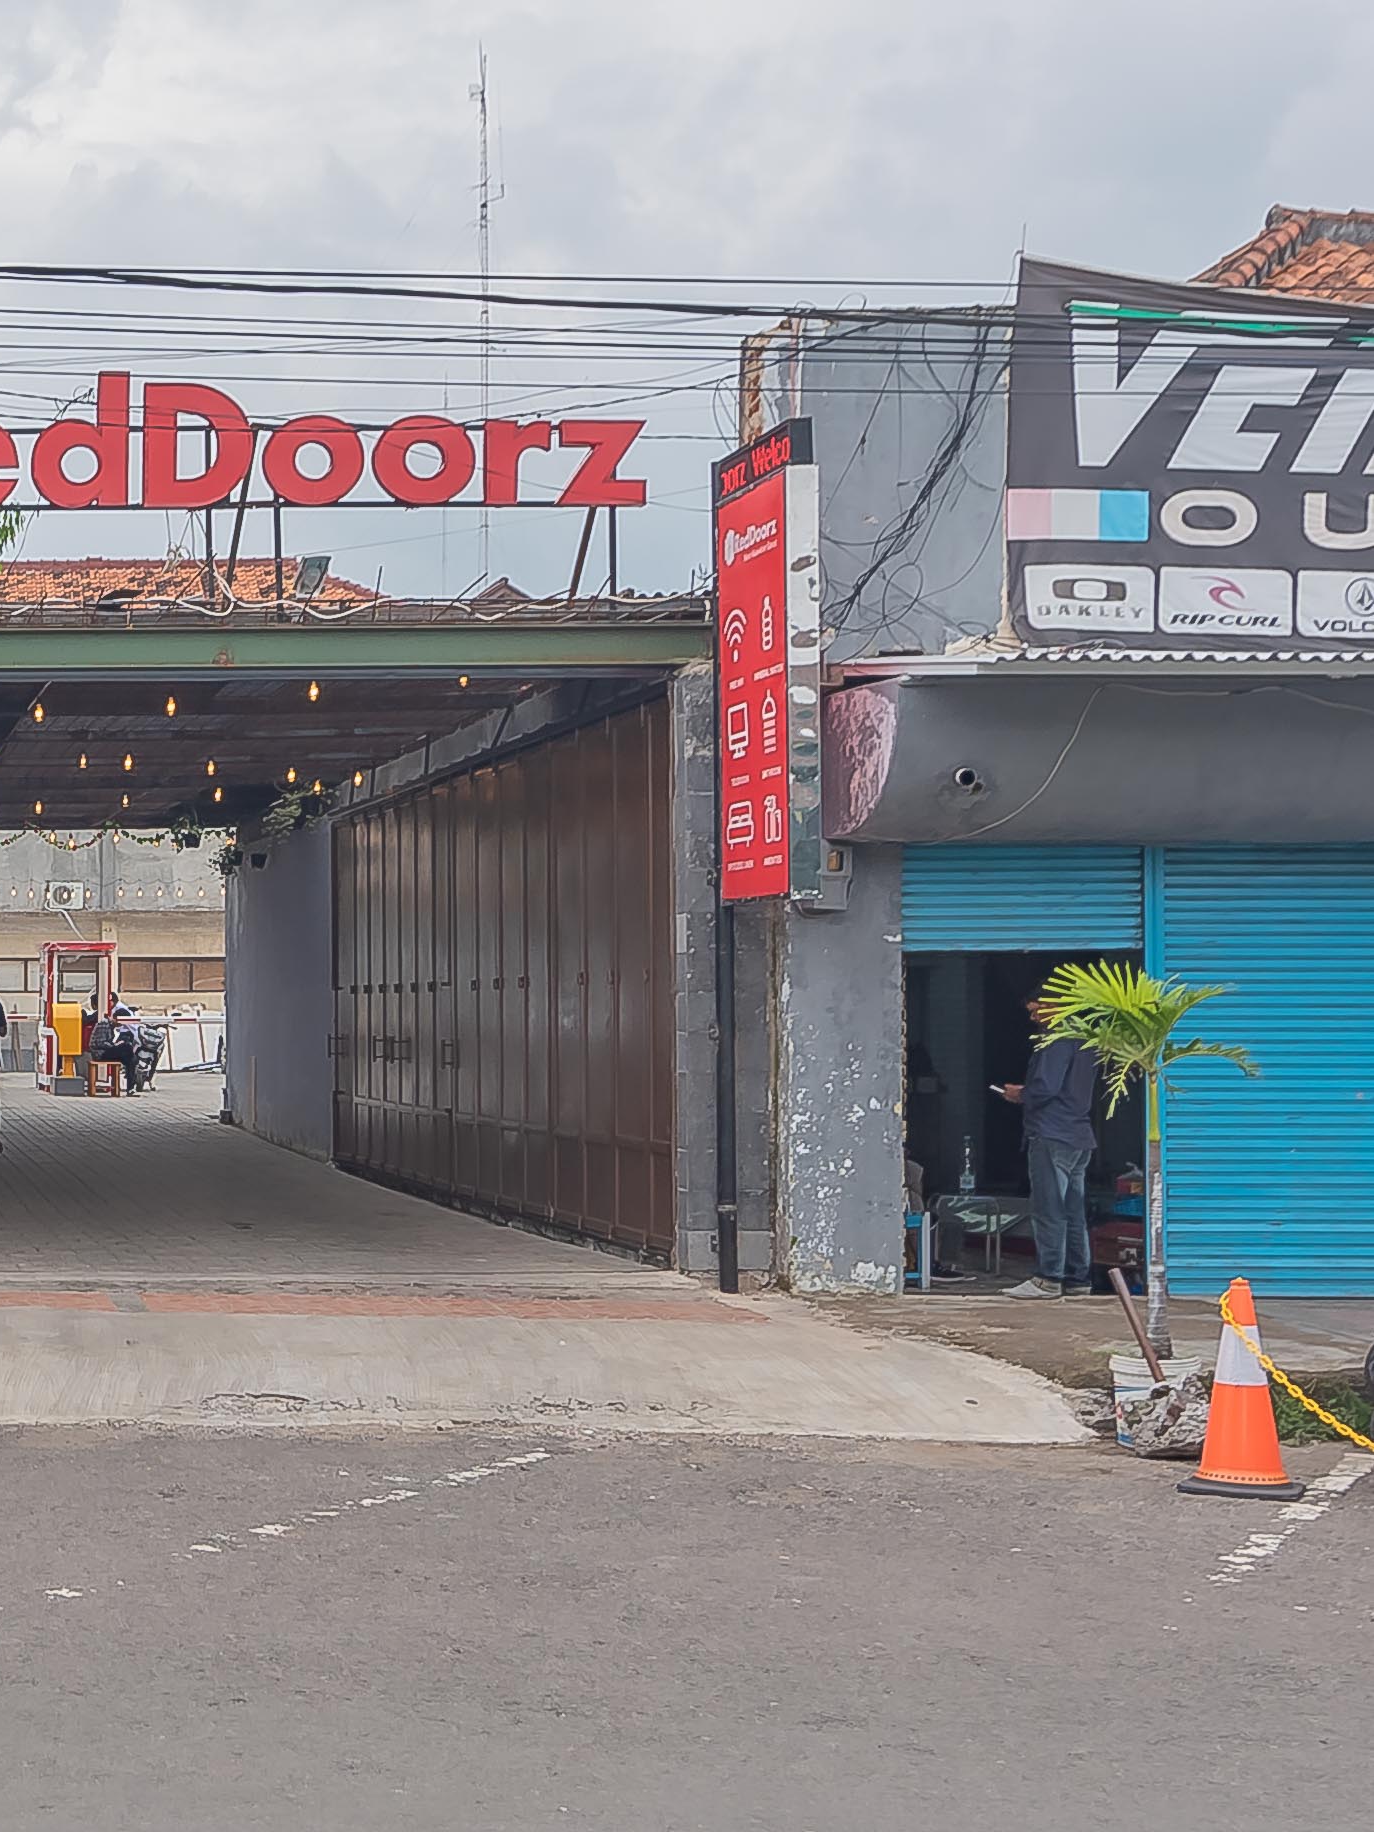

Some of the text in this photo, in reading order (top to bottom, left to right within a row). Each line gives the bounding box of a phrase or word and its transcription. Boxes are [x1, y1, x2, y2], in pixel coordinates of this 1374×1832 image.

[1036, 604, 1146, 619] OAKLEY
[1169, 613, 1282, 627] RIP CURL
